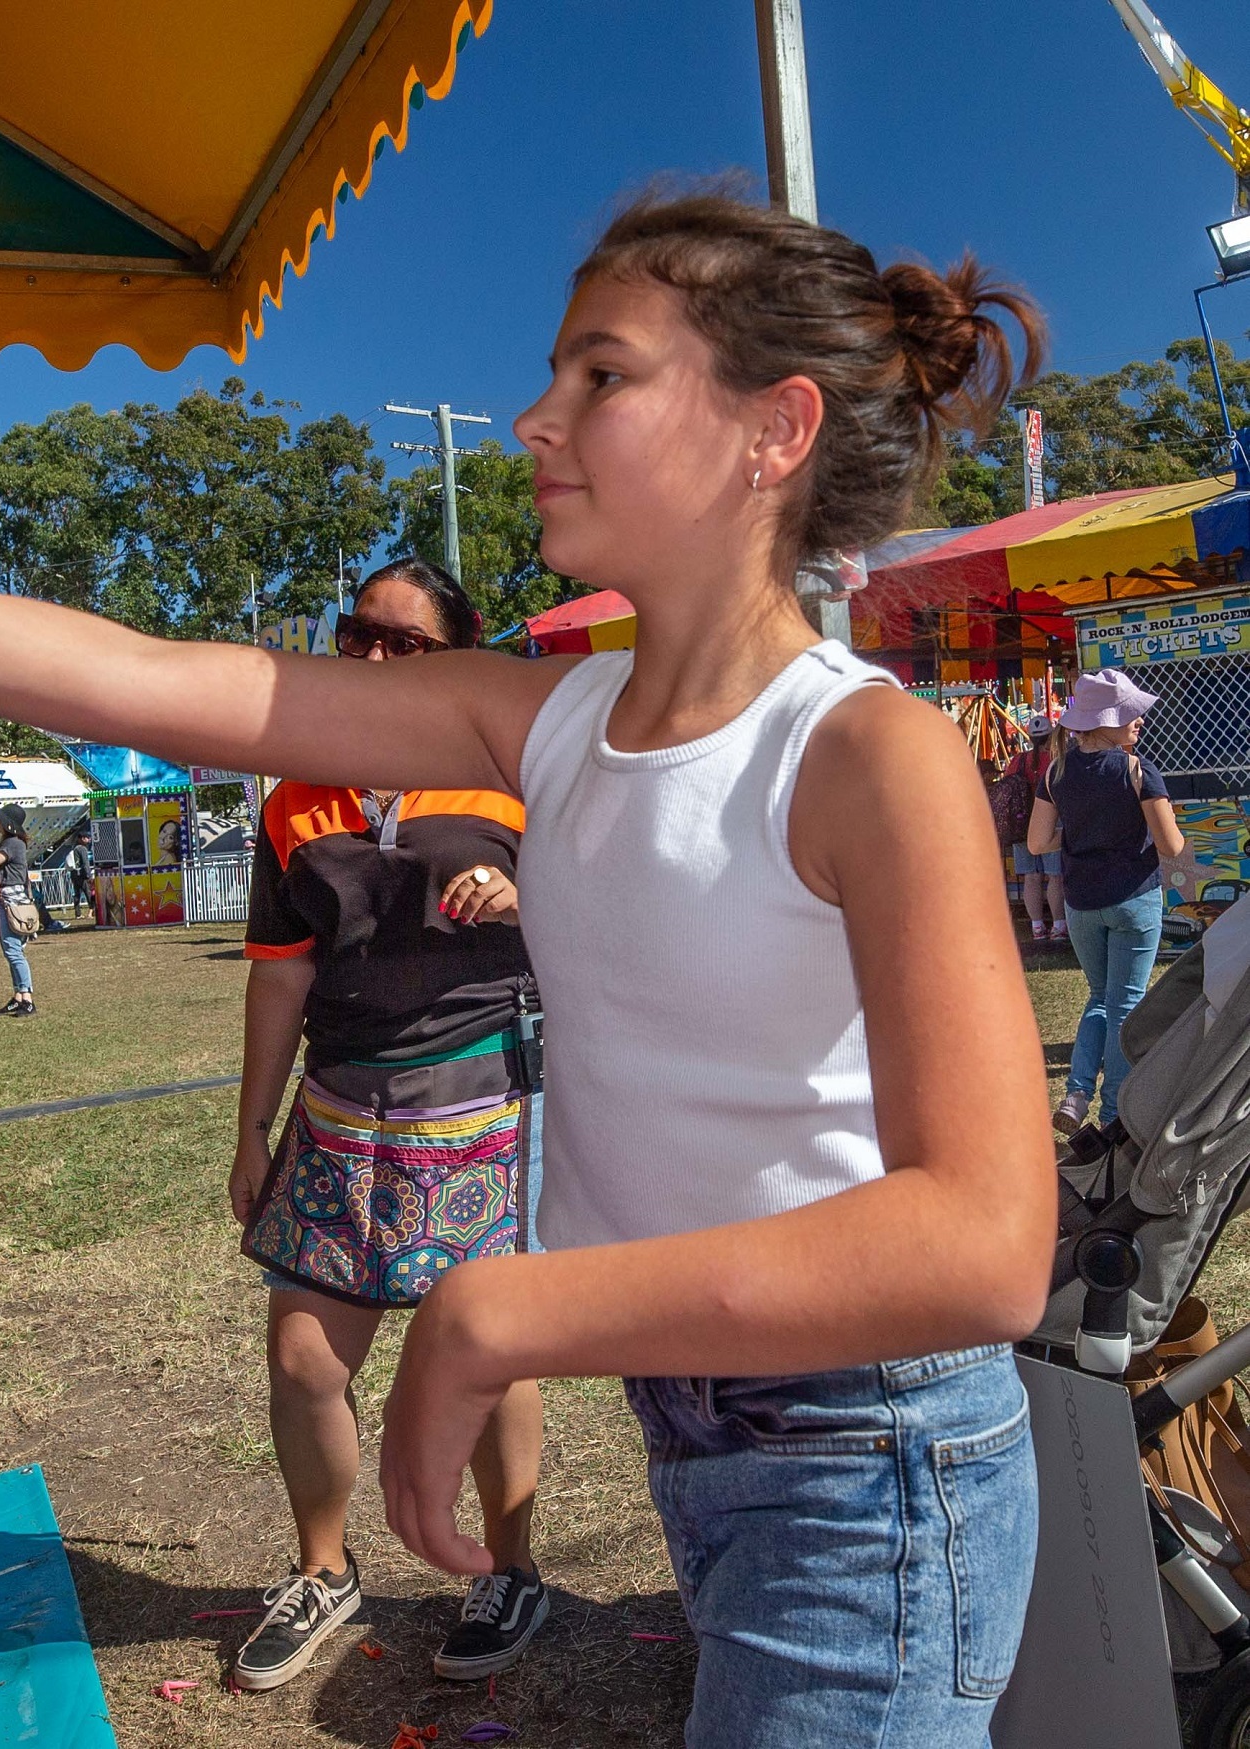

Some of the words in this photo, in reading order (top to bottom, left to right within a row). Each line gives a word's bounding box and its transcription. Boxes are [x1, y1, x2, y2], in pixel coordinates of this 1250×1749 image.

[1088, 626, 1125, 640] ROCK
[1150, 618, 1188, 631] ROLL
[1108, 624, 1242, 660] TICKETS
